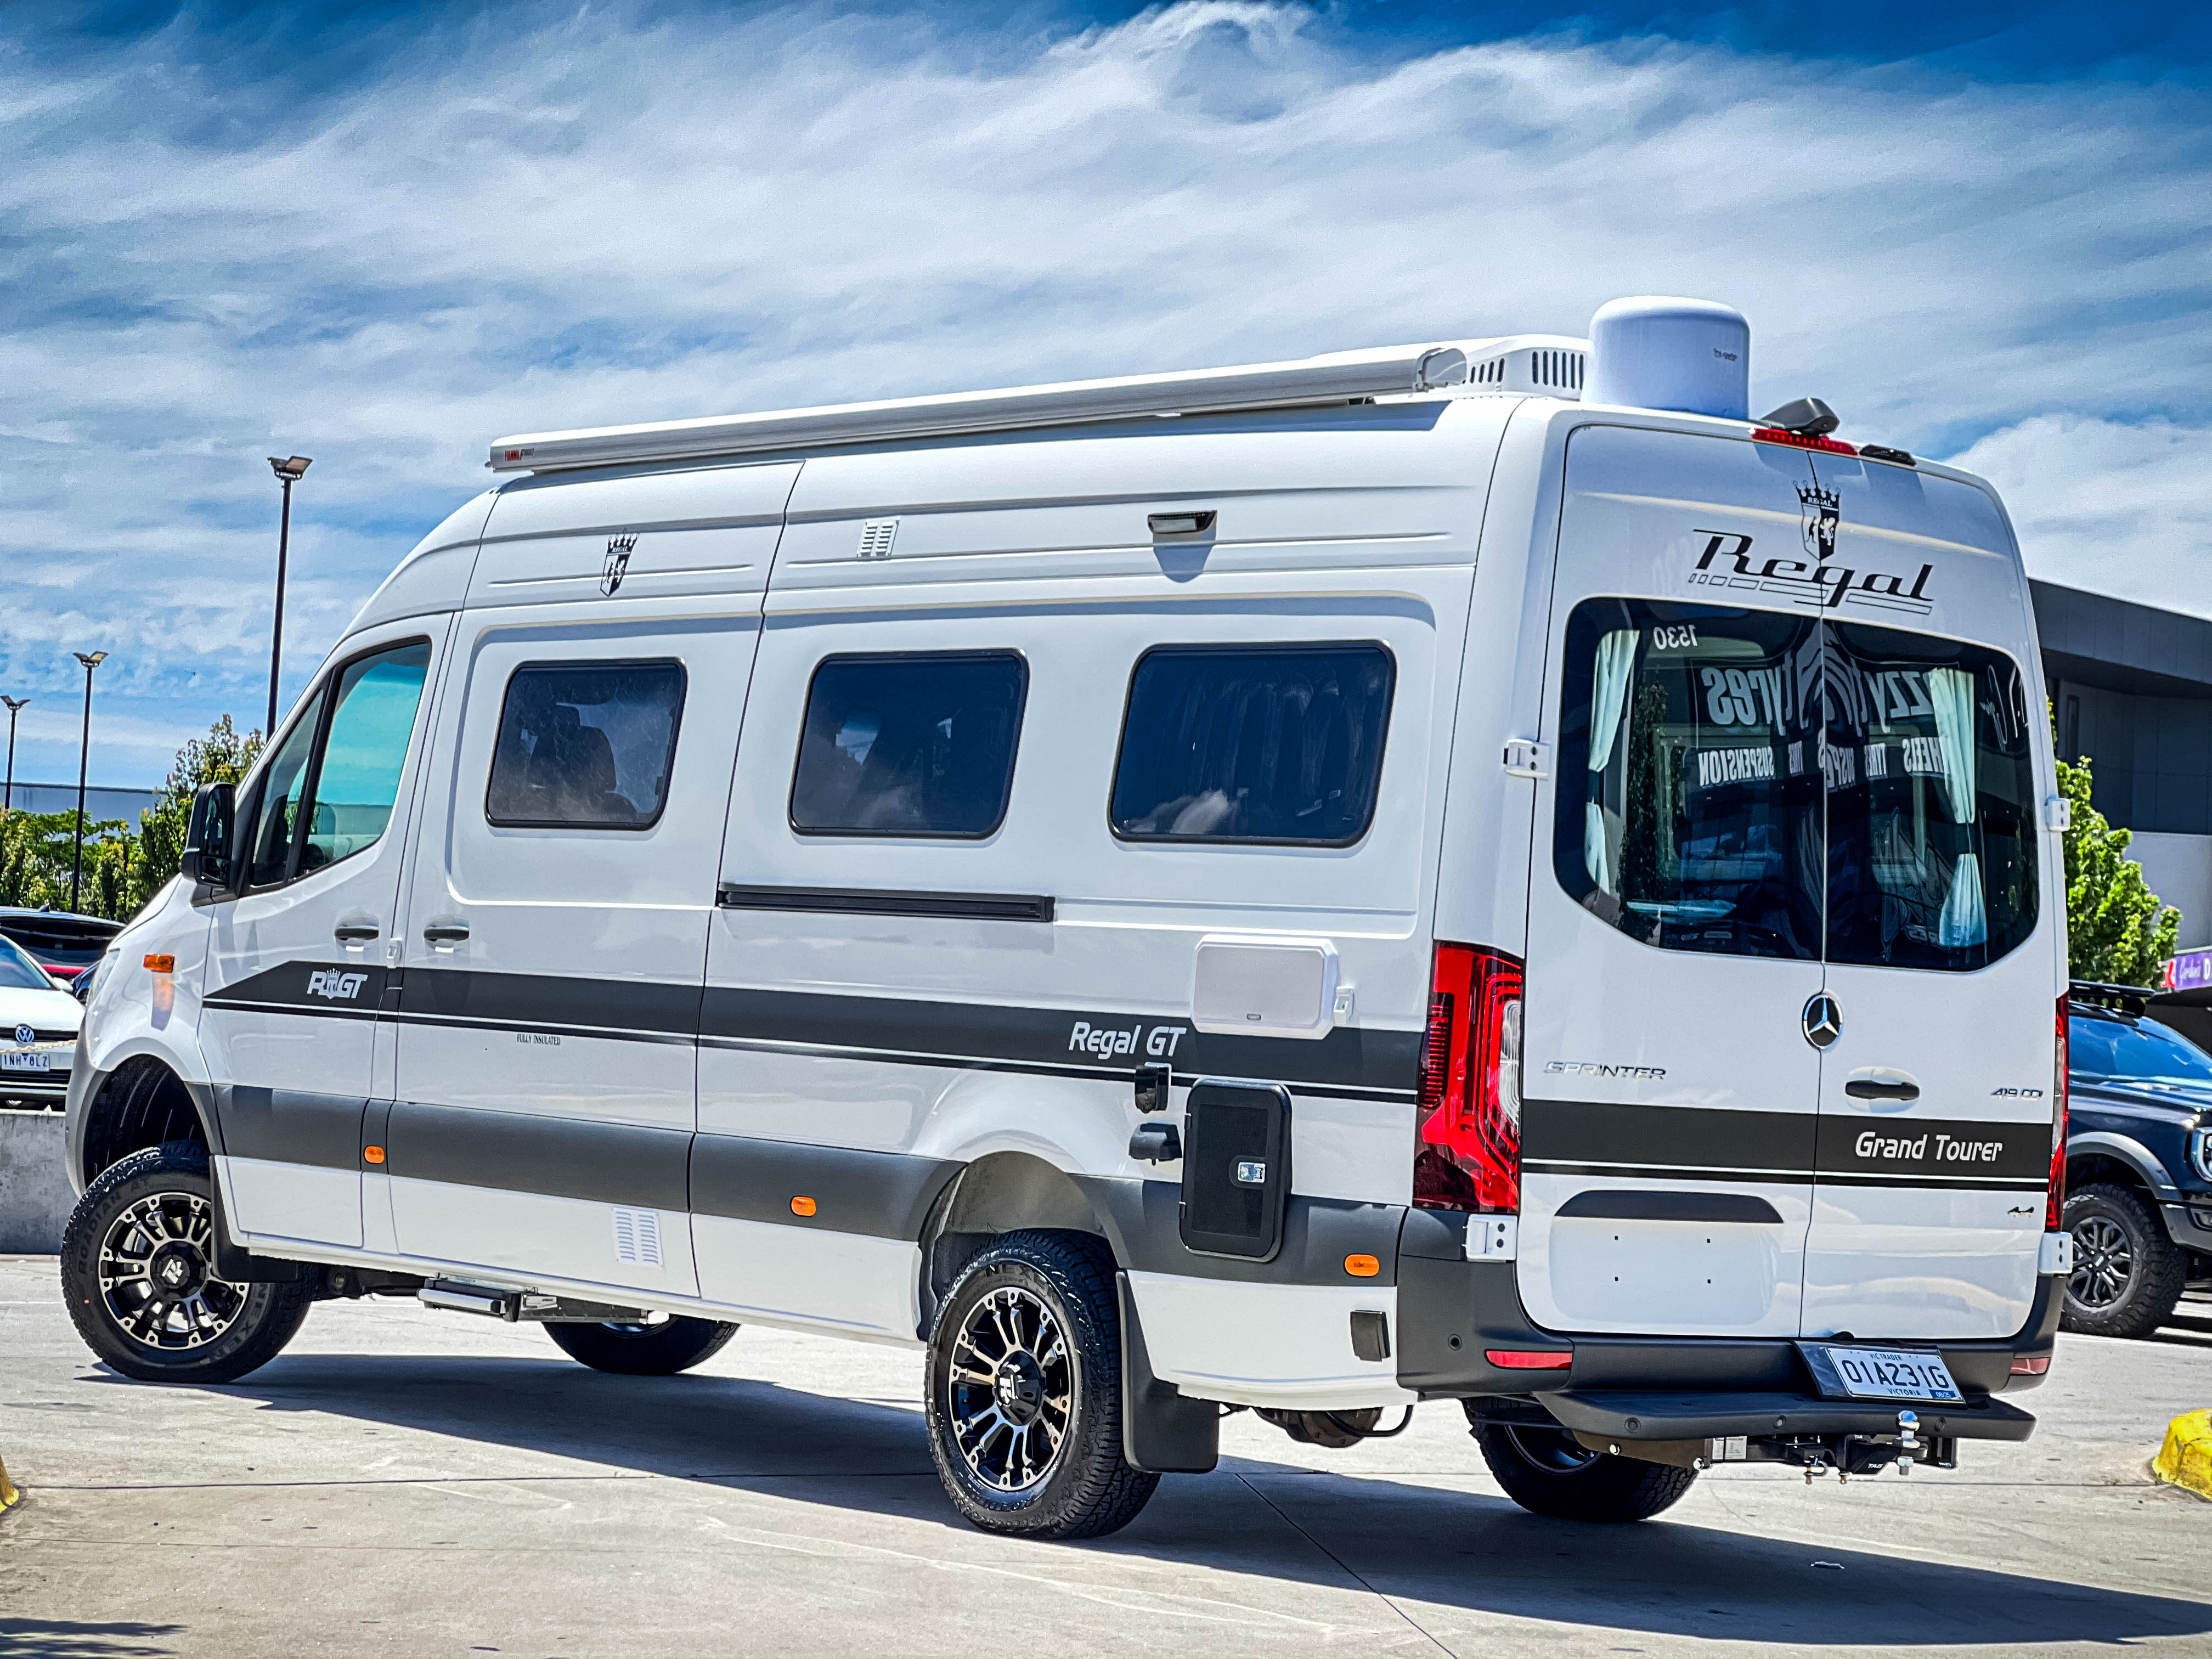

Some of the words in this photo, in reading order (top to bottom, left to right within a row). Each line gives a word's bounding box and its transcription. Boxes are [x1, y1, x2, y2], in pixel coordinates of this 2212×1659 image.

[1808, 496, 1832, 507] REGAL
[1693, 529, 1934, 608] Regal
[517, 1034, 532, 1043] FULLY
[533, 1035, 561, 1046] INSULATED
[1069, 1021, 1142, 1060] Regal
[1147, 1026, 1187, 1057] GT
[1544, 1062, 1667, 1080] SPRINTER
[1855, 1131, 1928, 1159] Grand
[1936, 1134, 2003, 1161] Tourer
[1887, 1388, 1921, 1396] VICTORIA
